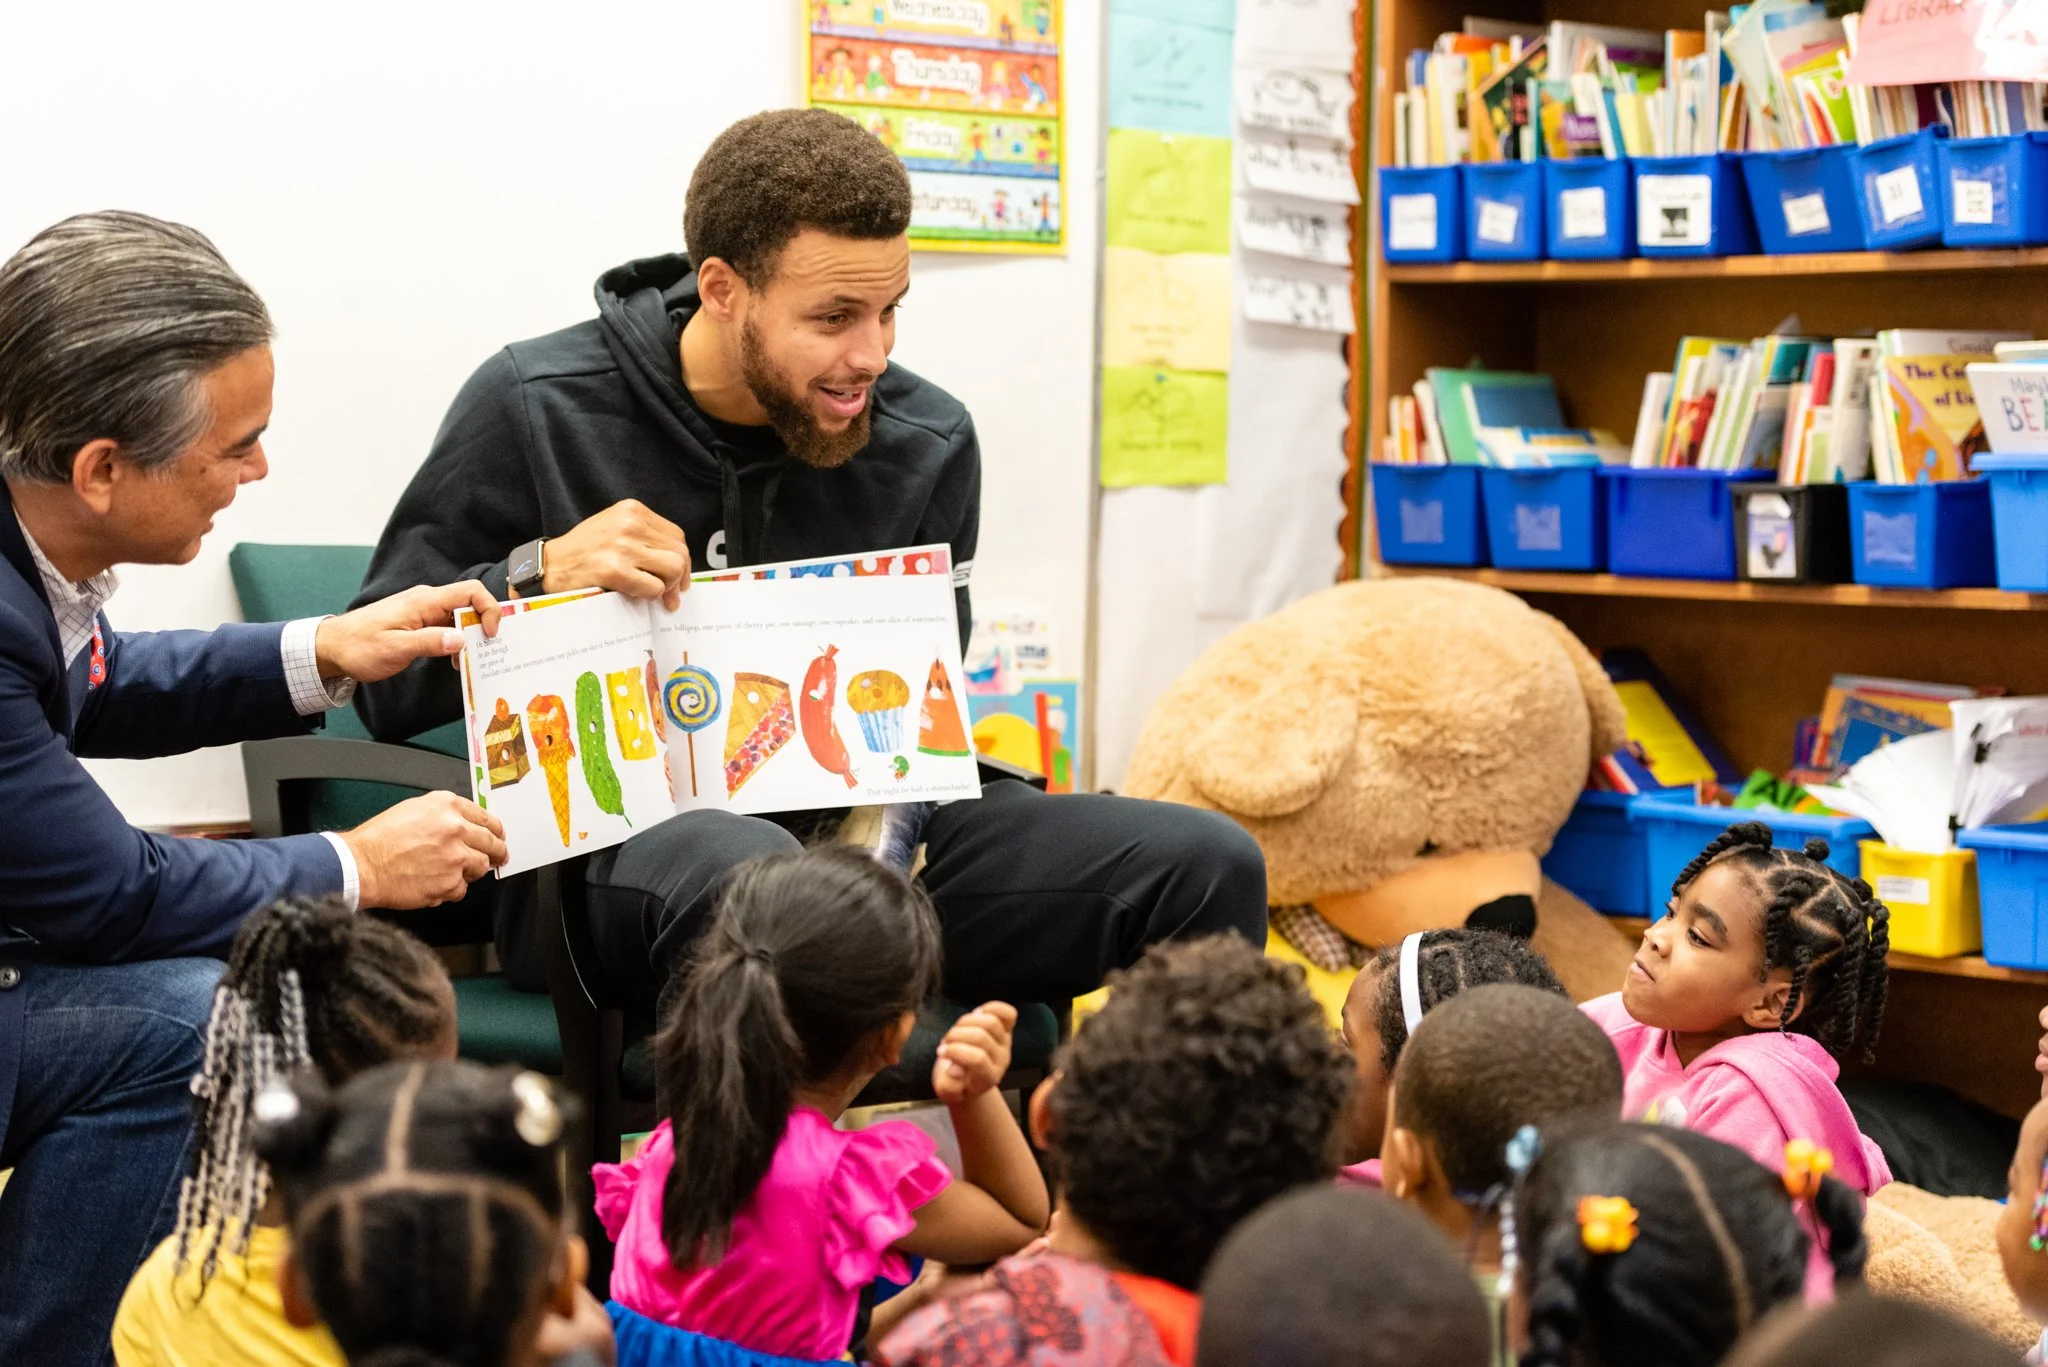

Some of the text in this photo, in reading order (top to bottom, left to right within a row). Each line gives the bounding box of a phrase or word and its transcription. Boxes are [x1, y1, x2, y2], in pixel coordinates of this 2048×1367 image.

[912, 191, 977, 219] aturday
[1904, 362, 1935, 379] The
[1934, 389, 1950, 407] of
[674, 623, 701, 635] lollipop,
[715, 623, 733, 633] piece
[743, 620, 763, 631] cherry
[862, 615, 874, 625] and
[866, 787, 881, 797] That
[911, 783, 923, 793] had
